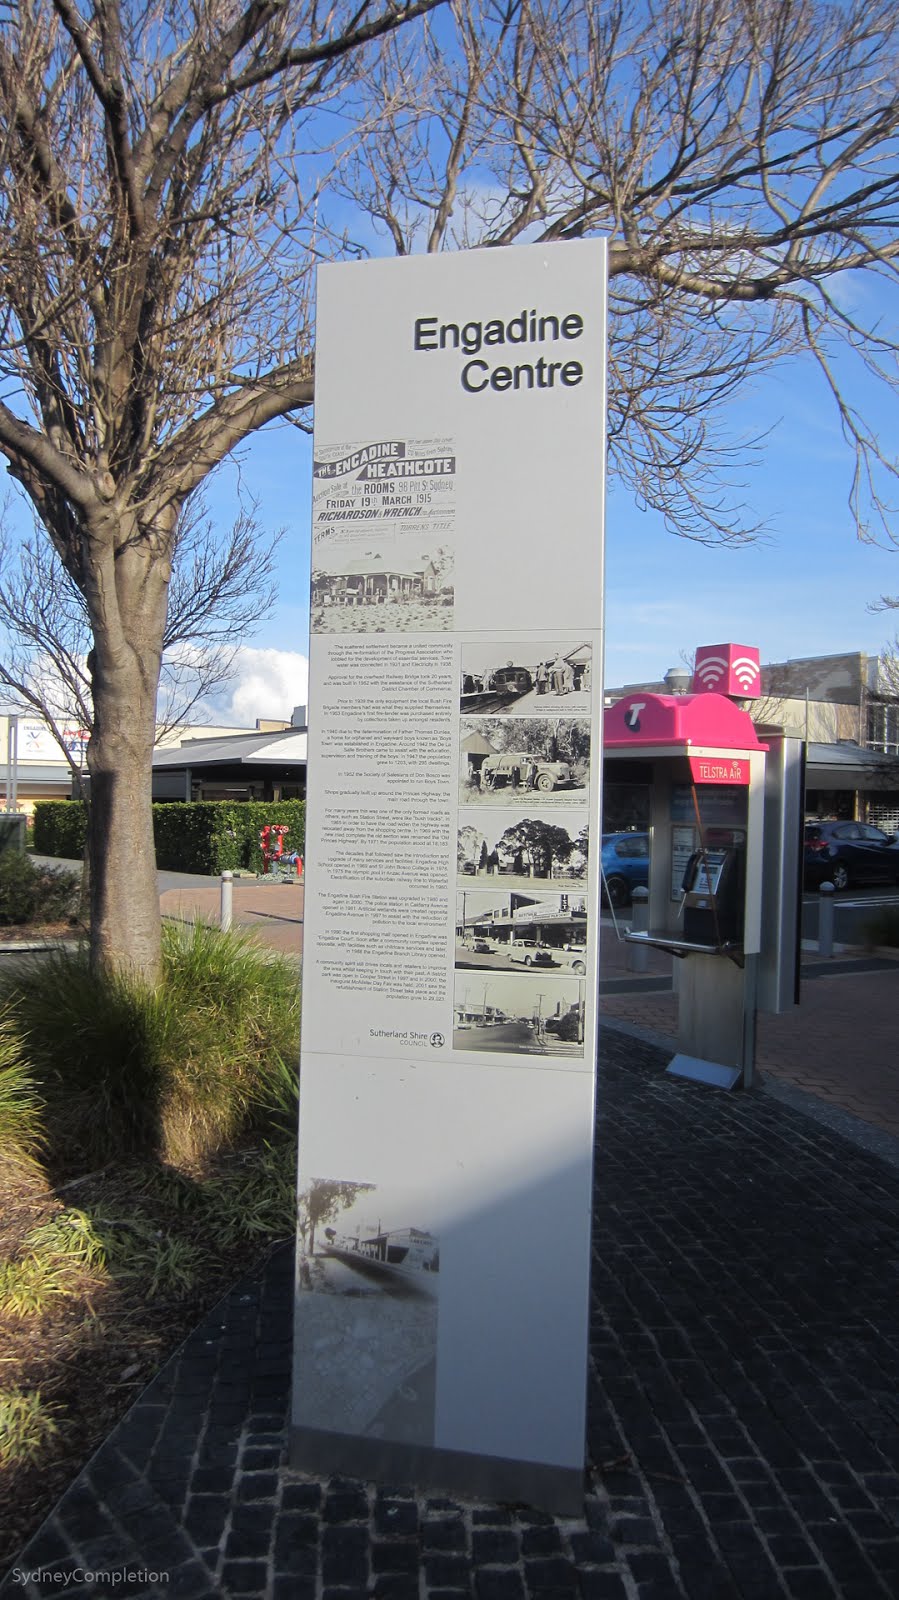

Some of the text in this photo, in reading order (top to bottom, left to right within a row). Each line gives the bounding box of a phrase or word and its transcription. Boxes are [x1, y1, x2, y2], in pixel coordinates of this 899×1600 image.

[414, 309, 583, 355] Engadine
[461, 357, 583, 393] Centre
[336, 443, 398, 475] ENGADINE
[368, 459, 451, 478] HEATHCOTE
[364, 482, 395, 494] ROOMS
[430, 479, 453, 492] Sydney
[326, 499, 355, 508] FRIDAY
[382, 496, 411, 505] MARCH
[416, 493, 431, 503] 1915
[317, 509, 379, 521] RICHARDSON
[383, 507, 422, 518] WRENCH
[314, 527, 335, 544] TERMS
[699, 766, 728, 779] TELSTRA
[370, 1029, 428, 1040] Sutherland Shire
